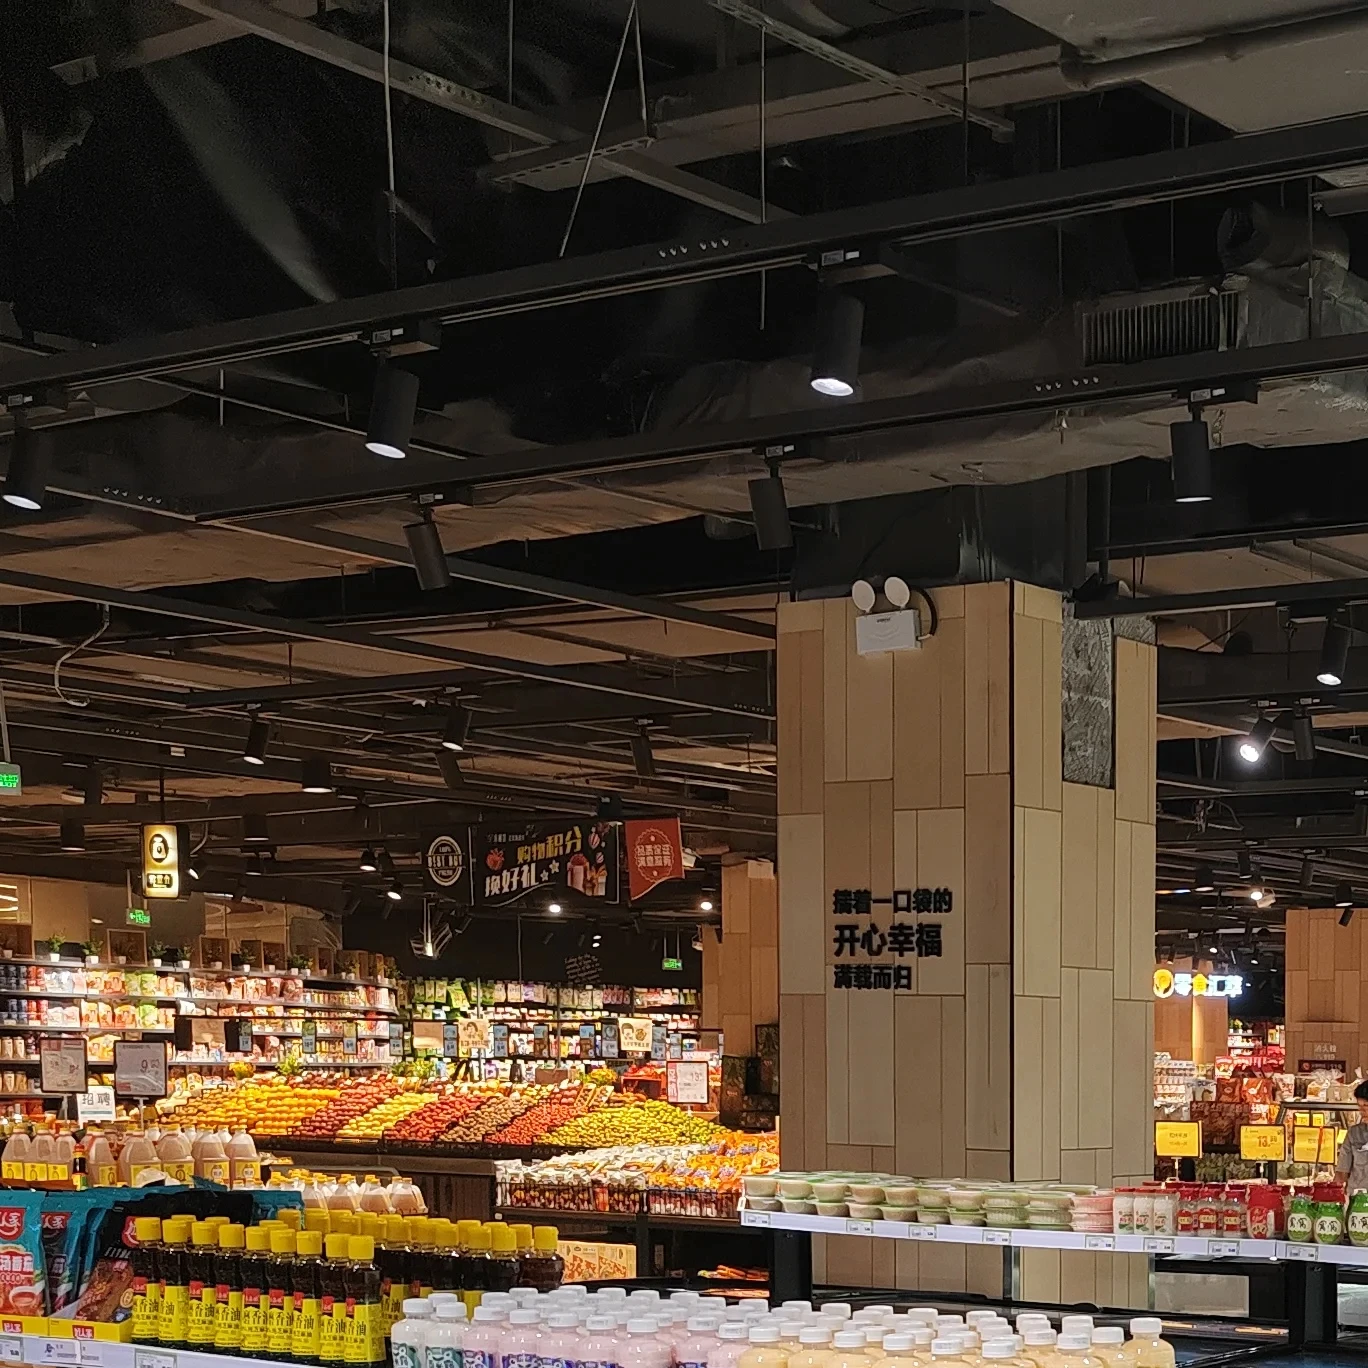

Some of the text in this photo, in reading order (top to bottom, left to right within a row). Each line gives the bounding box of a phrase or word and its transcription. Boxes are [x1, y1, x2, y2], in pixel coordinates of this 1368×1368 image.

[517, 826, 582, 864] 购物积分
[428, 855, 445, 867] BEST
[485, 864, 539, 898] 换好礼
[833, 922, 942, 957] 开心幸福
[833, 964, 912, 990] 满载而归
[81, 1092, 110, 1106] 招聘
